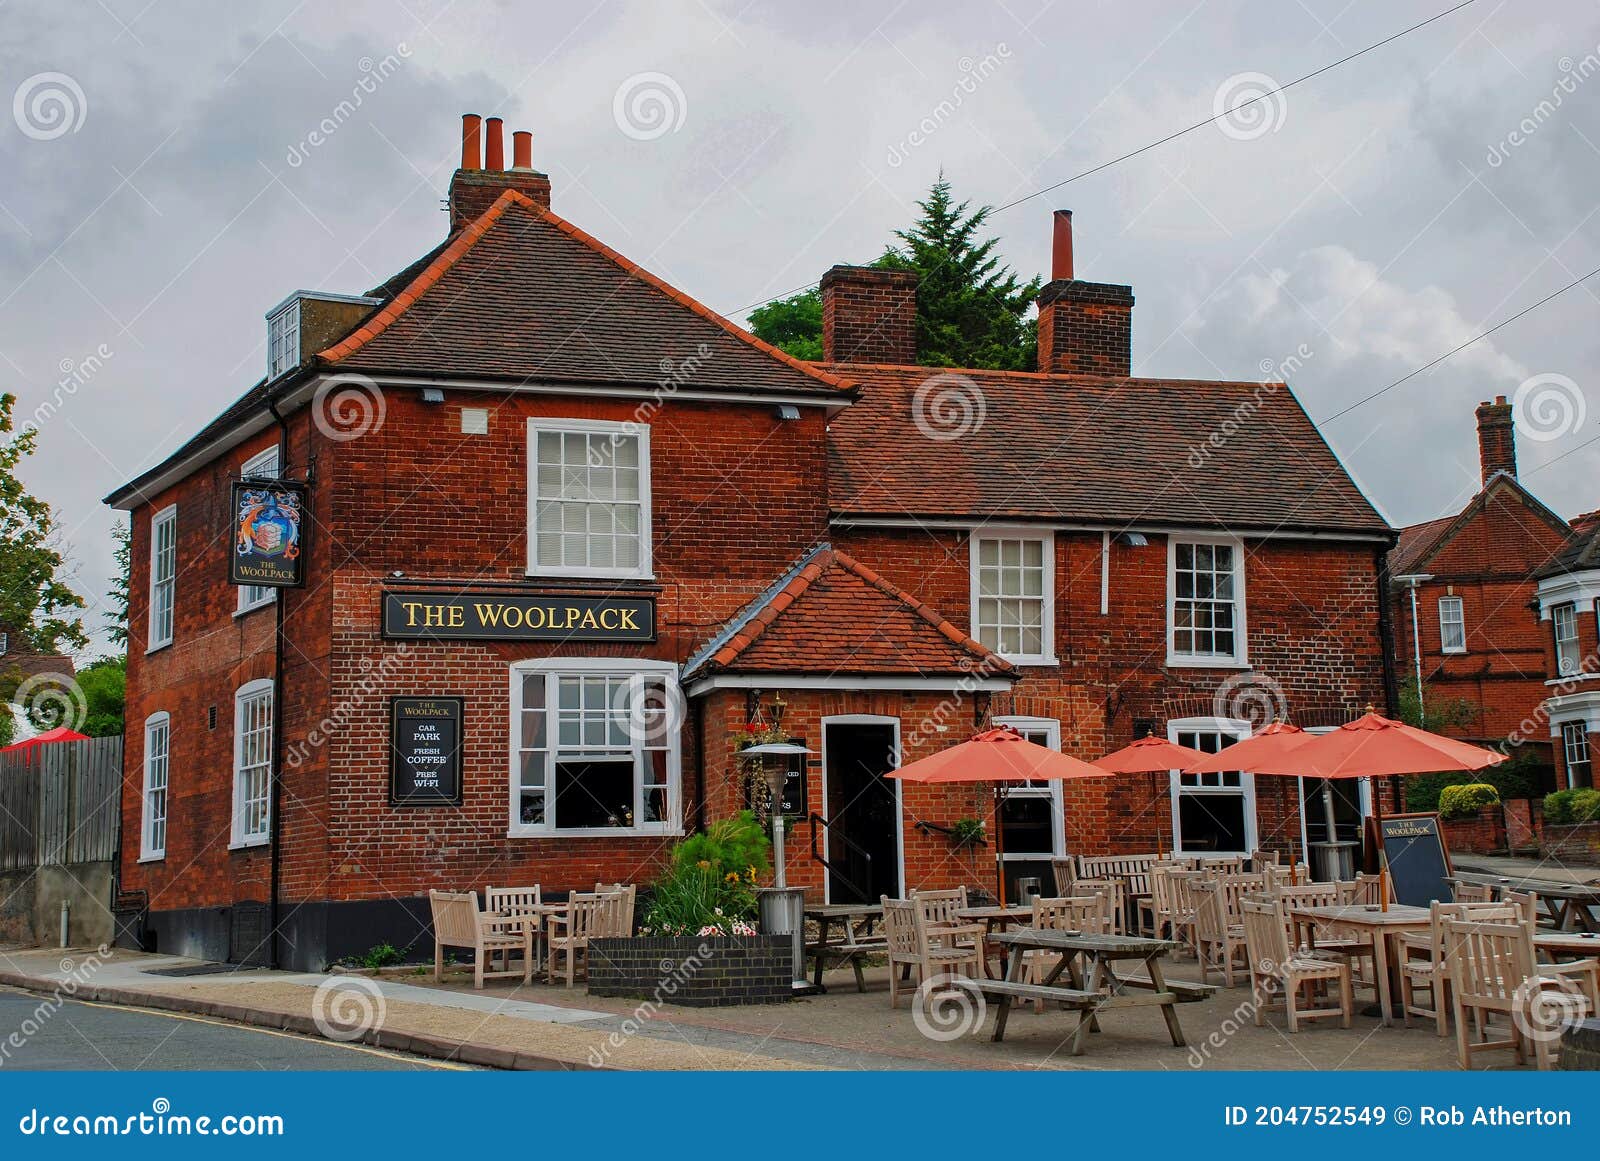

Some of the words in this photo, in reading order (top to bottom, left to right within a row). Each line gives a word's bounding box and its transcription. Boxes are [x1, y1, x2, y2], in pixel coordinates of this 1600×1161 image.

[260, 561, 276, 569] THE
[239, 566, 296, 580] WOOLPACK
[402, 602, 465, 628] THE
[473, 603, 641, 630] WOOLPACK
[404, 707, 449, 716] WOOLPACK
[413, 733, 441, 741] PARK
[407, 756, 447, 764] COFFEE
[413, 779, 439, 787] WI-FI
[1385, 826, 1430, 836] WOOLPACK
